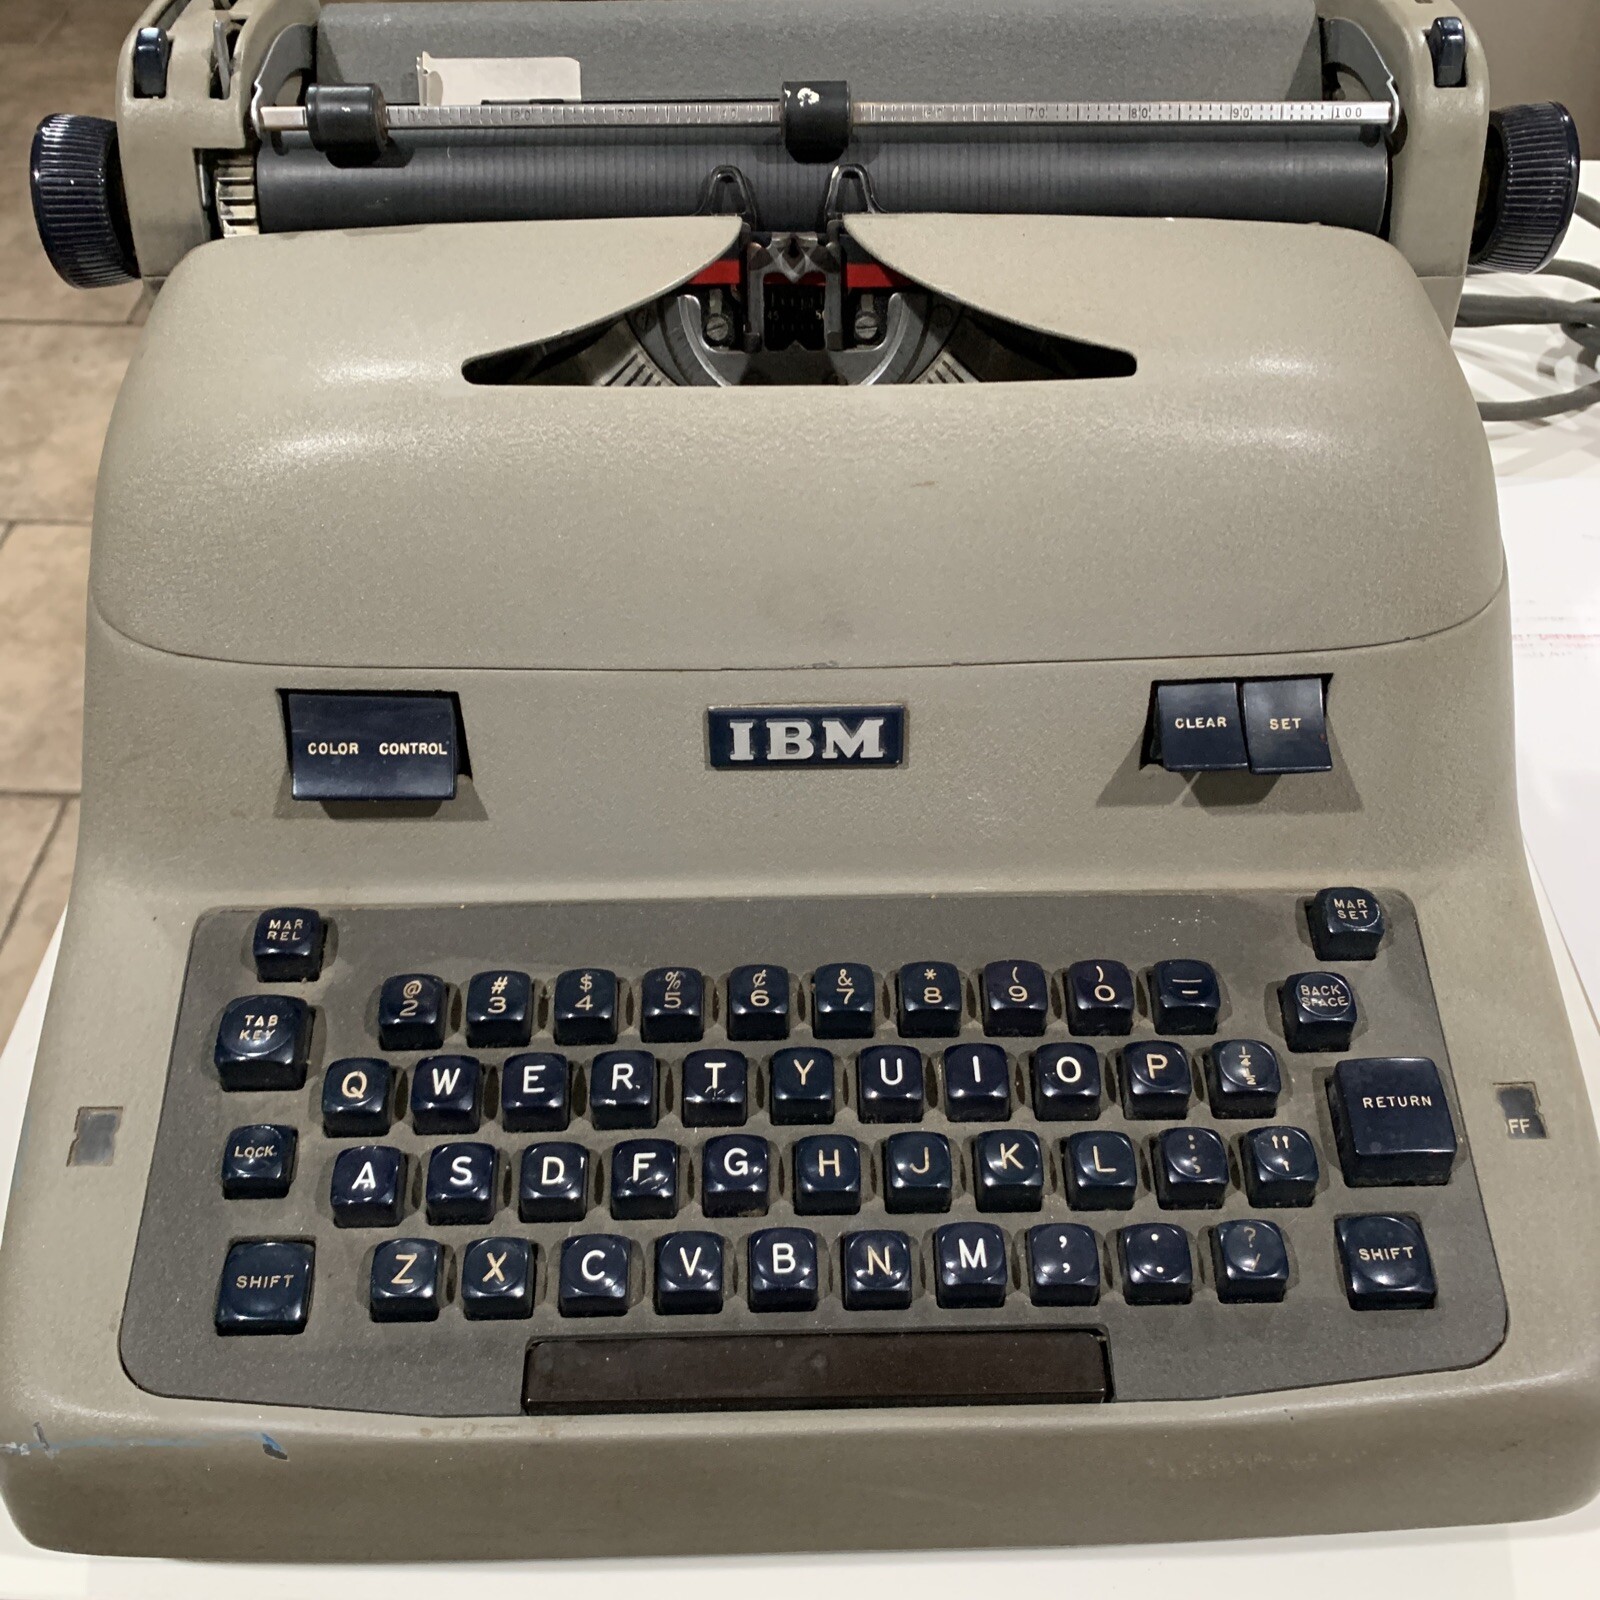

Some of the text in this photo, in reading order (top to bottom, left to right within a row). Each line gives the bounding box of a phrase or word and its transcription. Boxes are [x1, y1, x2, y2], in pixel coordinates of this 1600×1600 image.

[1029, 107, 1045, 119] 70
[1131, 107, 1148, 119] 80
[1233, 107, 1250, 119] 90
[1335, 107, 1362, 118] 100
[1174, 716, 1227, 729] CLEAR
[1269, 717, 1302, 730] SET
[307, 742, 448, 756] COLOR CONTROL
[729, 718, 885, 761] IBM
[1333, 898, 1367, 909] MAR
[1337, 910, 1368, 920] SET
[267, 930, 301, 941] REL
[269, 918, 303, 930] MAR
[663, 992, 682, 1009] 5
[750, 990, 770, 1007] 6
[836, 988, 854, 1004] 7
[923, 986, 942, 1002] 8
[1008, 985, 1028, 1002] 9
[1094, 984, 1116, 1002] 0
[1301, 984, 1341, 996] BACK
[1301, 996, 1349, 1007] SPACE
[399, 1000, 417, 1017] 2
[487, 997, 507, 1014] 3
[574, 996, 594, 1011] 4
[244, 1014, 279, 1027] TAB
[239, 1029, 276, 1041] KEY
[523, 1065, 546, 1092] E
[612, 1063, 634, 1090] R
[704, 1062, 727, 1088] T
[793, 1059, 814, 1085] Y
[880, 1058, 902, 1084] U
[973, 1056, 980, 1082] I
[1056, 1056, 1082, 1083] O
[1147, 1053, 1168, 1079] P
[341, 1071, 367, 1099] Q
[432, 1067, 461, 1095] W
[1362, 1095, 1433, 1108] RETURN
[1508, 1118, 1530, 1134] FF
[234, 1145, 274, 1158] LOCK
[724, 1148, 747, 1176] G
[819, 1150, 841, 1177] H
[910, 1146, 930, 1173] J
[1000, 1143, 1024, 1170] K
[1094, 1146, 1117, 1172] L
[352, 1161, 376, 1190] A
[450, 1156, 472, 1184] S
[542, 1156, 564, 1184] D
[632, 1153, 656, 1181] F
[482, 1251, 507, 1281] X
[581, 1250, 606, 1279] C
[679, 1247, 702, 1276] V
[772, 1243, 796, 1272] B
[867, 1246, 892, 1275] N
[958, 1238, 986, 1268] M
[1359, 1246, 1415, 1261] SHIFT
[236, 1274, 295, 1289] SHIFT
[391, 1254, 417, 1284] Z
